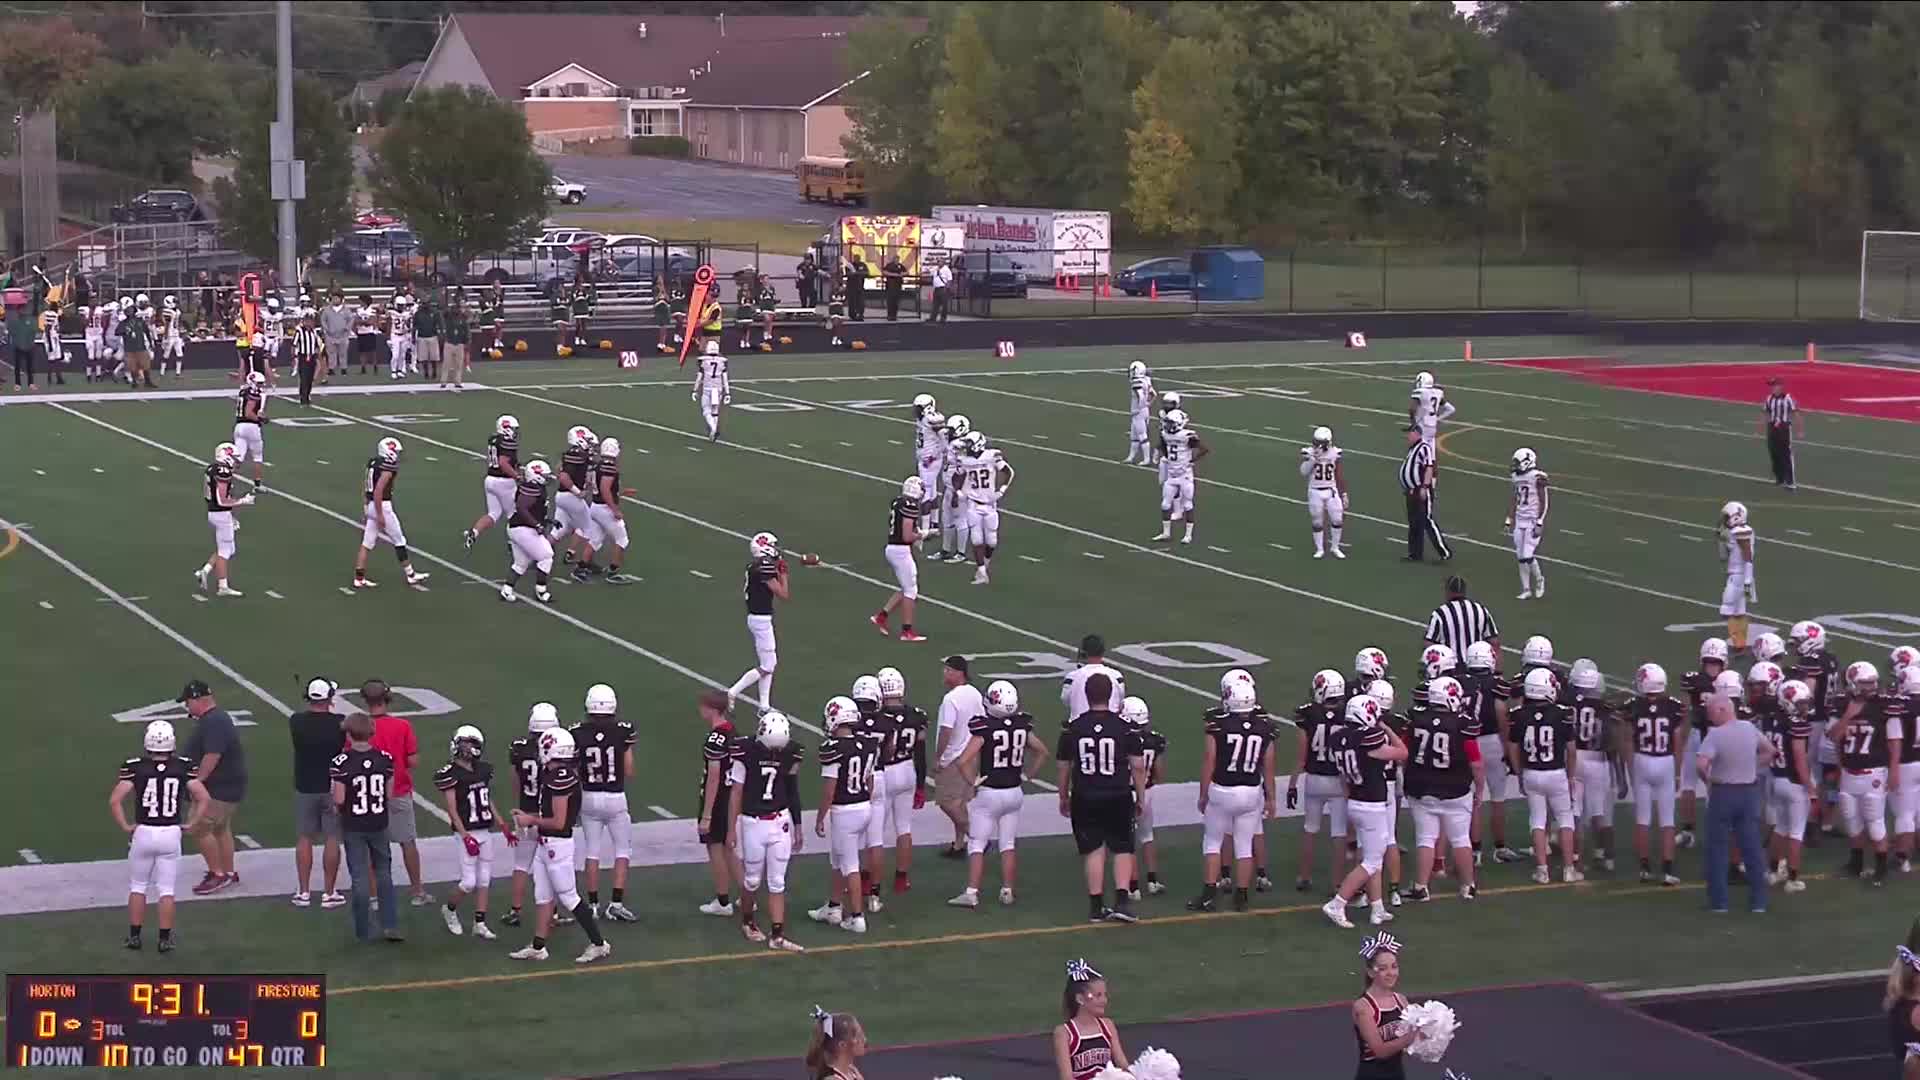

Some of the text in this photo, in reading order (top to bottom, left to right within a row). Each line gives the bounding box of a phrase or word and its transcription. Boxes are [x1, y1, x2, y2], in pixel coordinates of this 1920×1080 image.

[1000, 341, 1015, 357] 10
[1351, 332, 1366, 347] G
[622, 351, 638, 367] 20
[709, 361, 719, 378] 7
[968, 468, 991, 490] 32
[707, 731, 727, 746] 22
[992, 729, 1026, 769] 28
[1225, 733, 1263, 774] 70
[1413, 728, 1450, 769] 79
[1523, 725, 1554, 763] 49
[1637, 717, 1670, 753] 26
[585, 746, 617, 784] 21
[1077, 737, 1116, 776] 60
[142, 778, 180, 818] 40
[351, 774, 386, 815] 39
[761, 766, 777, 799] 7
